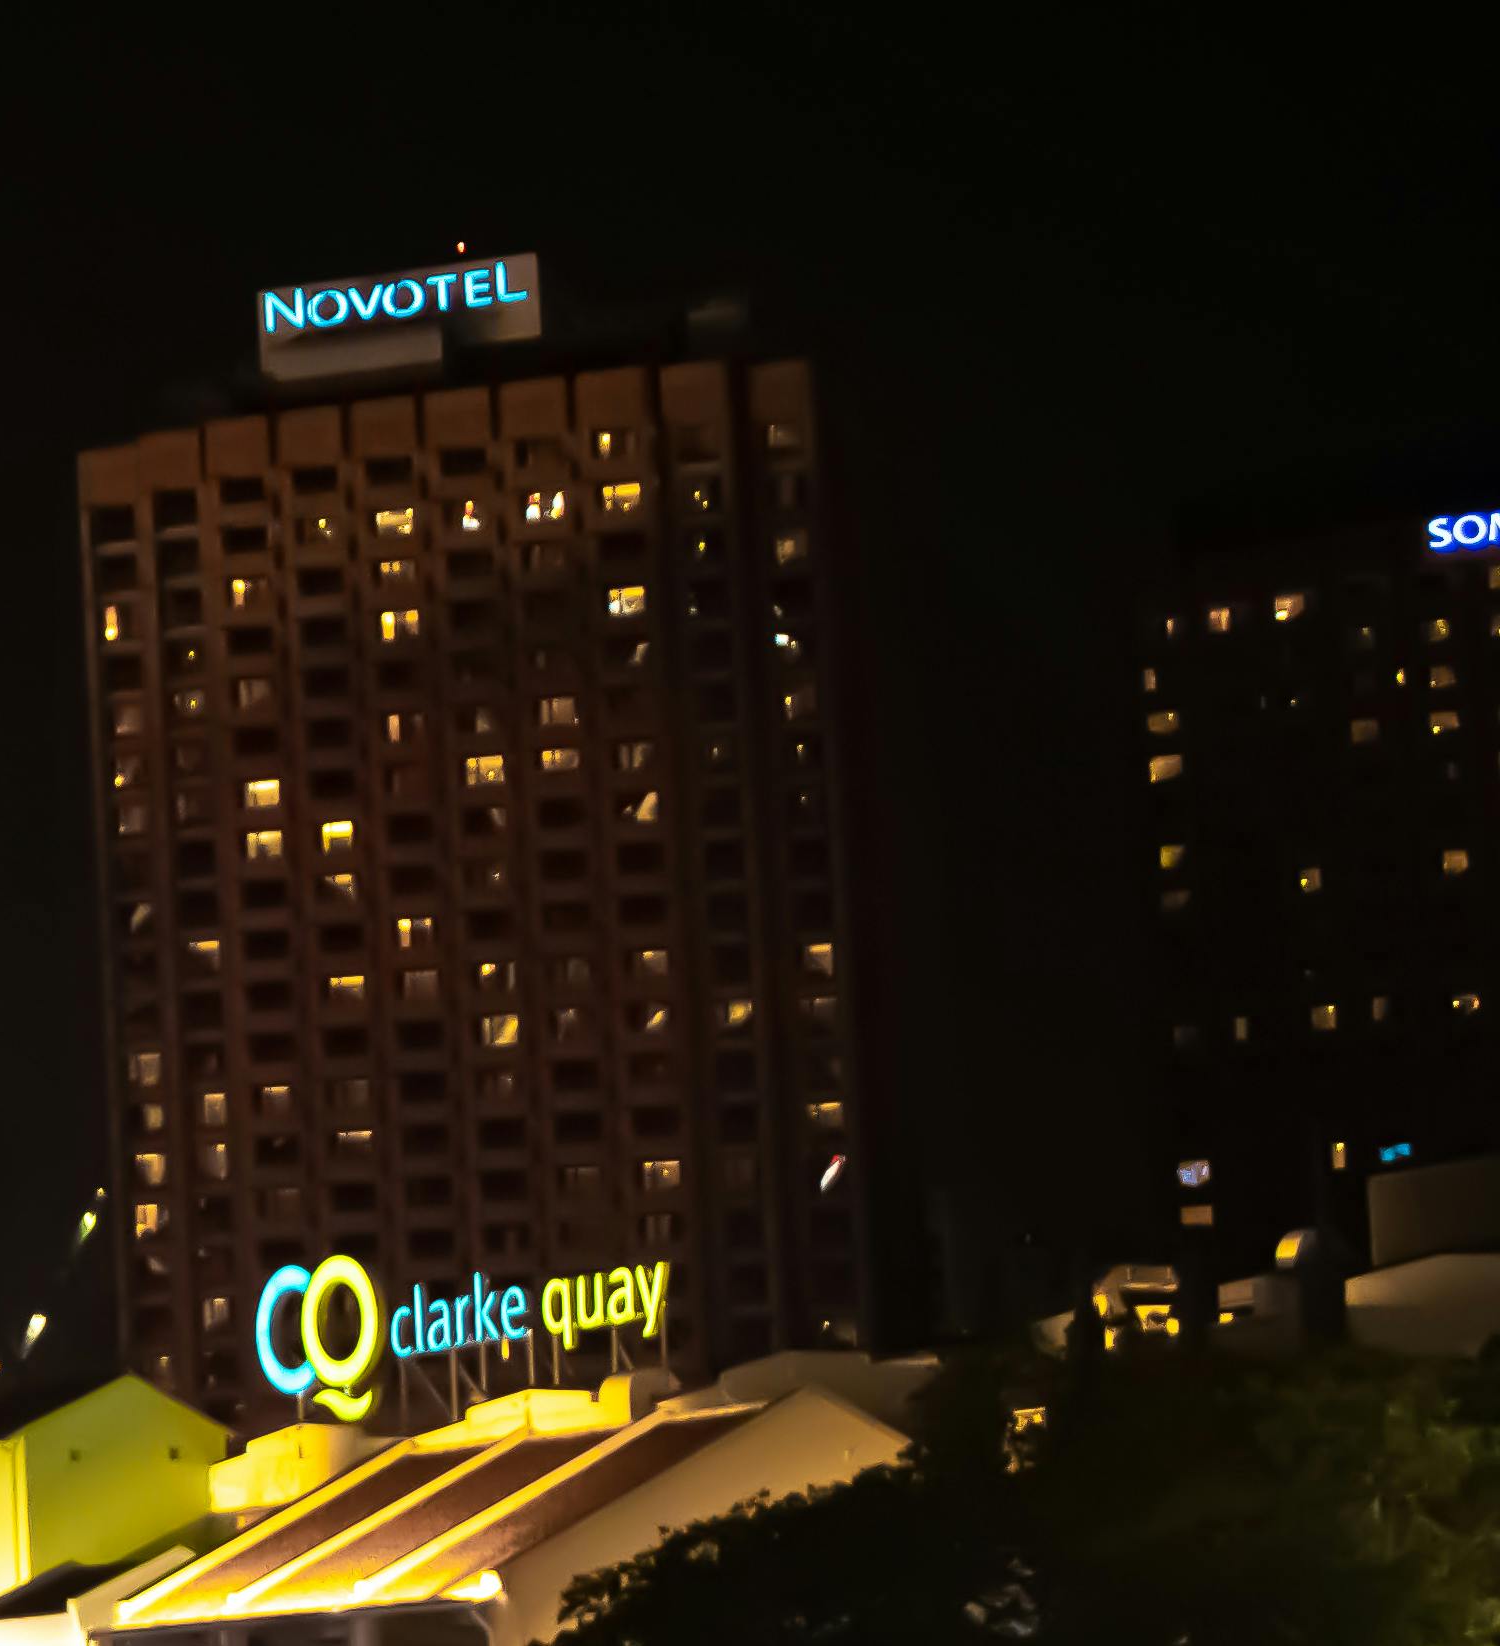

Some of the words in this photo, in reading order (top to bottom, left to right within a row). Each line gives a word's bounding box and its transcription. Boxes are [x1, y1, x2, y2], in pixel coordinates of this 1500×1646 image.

[262, 261, 528, 334] NOVOTEL
[255, 1254, 380, 1421] CQ
[390, 1271, 528, 1358] clarke
[541, 1261, 669, 1351] quay
